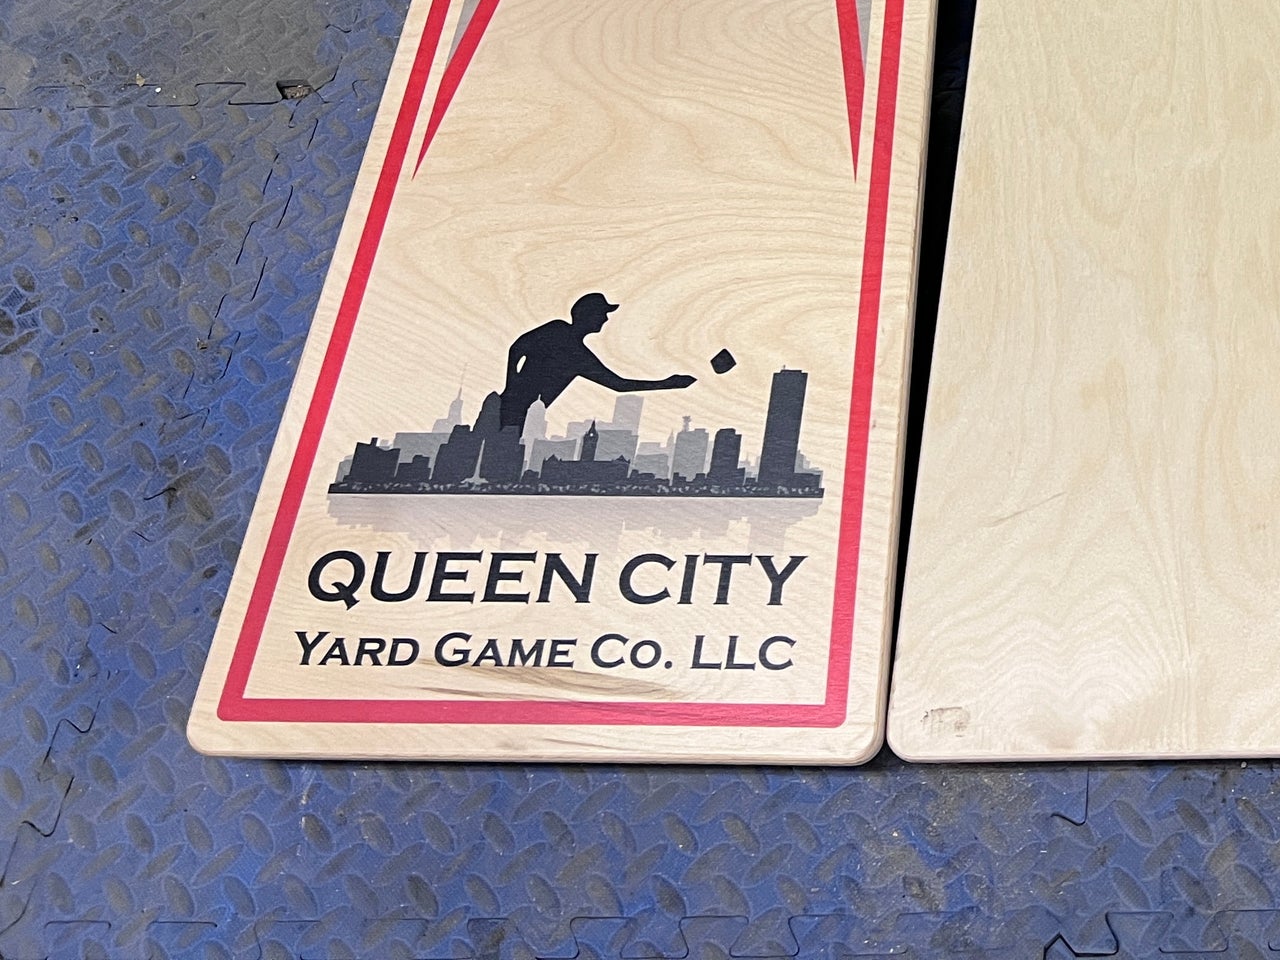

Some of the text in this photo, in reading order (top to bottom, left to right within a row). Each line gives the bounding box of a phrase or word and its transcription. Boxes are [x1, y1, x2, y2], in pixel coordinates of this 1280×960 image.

[307, 549, 808, 611] QUEEN CITY
[294, 631, 419, 667] YARD
[433, 632, 575, 669] GAME
[690, 635, 797, 671] LLC
